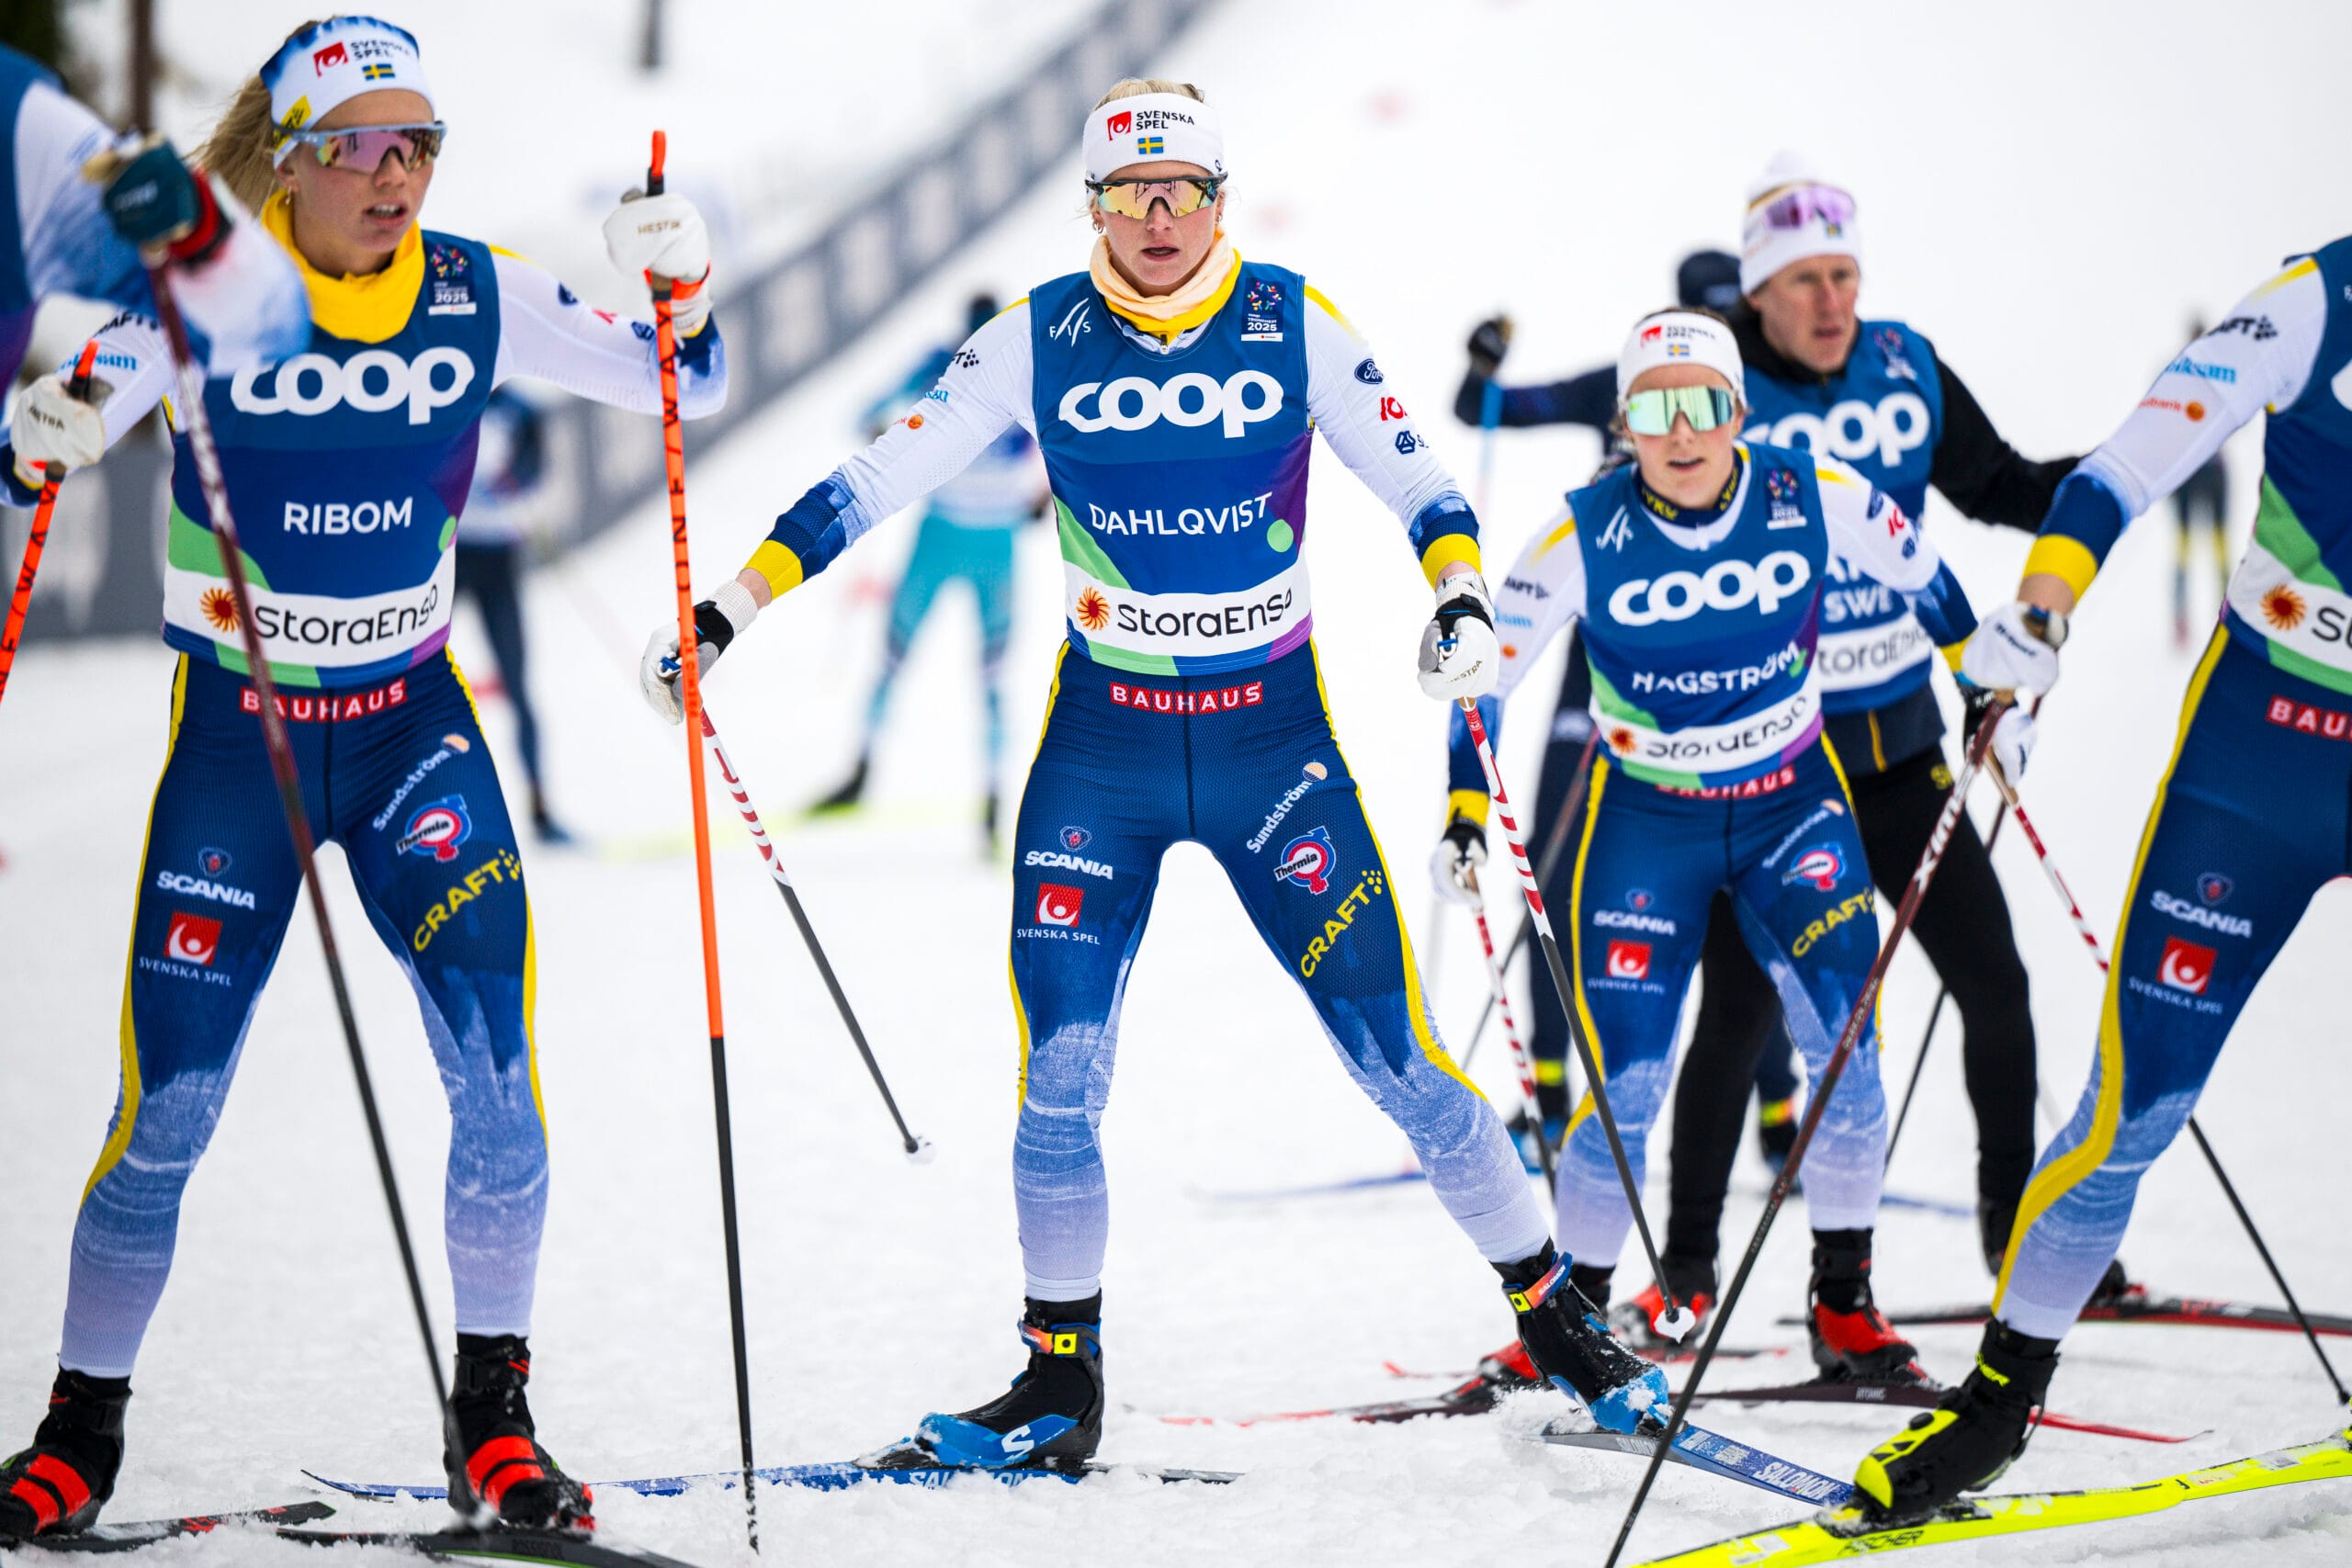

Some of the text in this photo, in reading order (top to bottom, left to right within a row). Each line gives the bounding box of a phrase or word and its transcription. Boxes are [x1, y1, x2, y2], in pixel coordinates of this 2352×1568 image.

[1136, 110, 1194, 126] SVENSKA
[1136, 119, 1169, 130] SPEL
[1248, 322, 1277, 332] 2025
[231, 345, 475, 425] coop
[1058, 369, 1284, 439] coop
[283, 497, 414, 536] RIBOM
[1088, 491, 1273, 536] DAHLQVIST
[1608, 550, 1811, 626] coop
[254, 584, 438, 647] StoraEnso
[1117, 586, 1293, 637] StoraEnso
[1446, 660, 1483, 684] STRA
[1112, 683, 1261, 714] BAUHAUS
[2269, 697, 2352, 738] BAU
[1657, 765, 1796, 800] AUHAUS
[398, 818, 450, 852] Thermia
[1246, 780, 1313, 854] Sundström
[1024, 851, 1114, 880] SCANIA
[1274, 851, 1319, 880] Thermia
[156, 871, 255, 910] SCANIA
[413, 857, 505, 953] CRAFT
[1300, 882, 1372, 978] CRAFT
[1592, 910, 1677, 936] SCANIA
[1792, 892, 1869, 957] CRAFT
[2150, 889, 2254, 938] SCANIA
[1016, 928, 1101, 945] SVENSKA SPEL
[139, 956, 232, 987] SVENSKA SPEL
[1754, 1461, 1843, 1501] SALOMON
